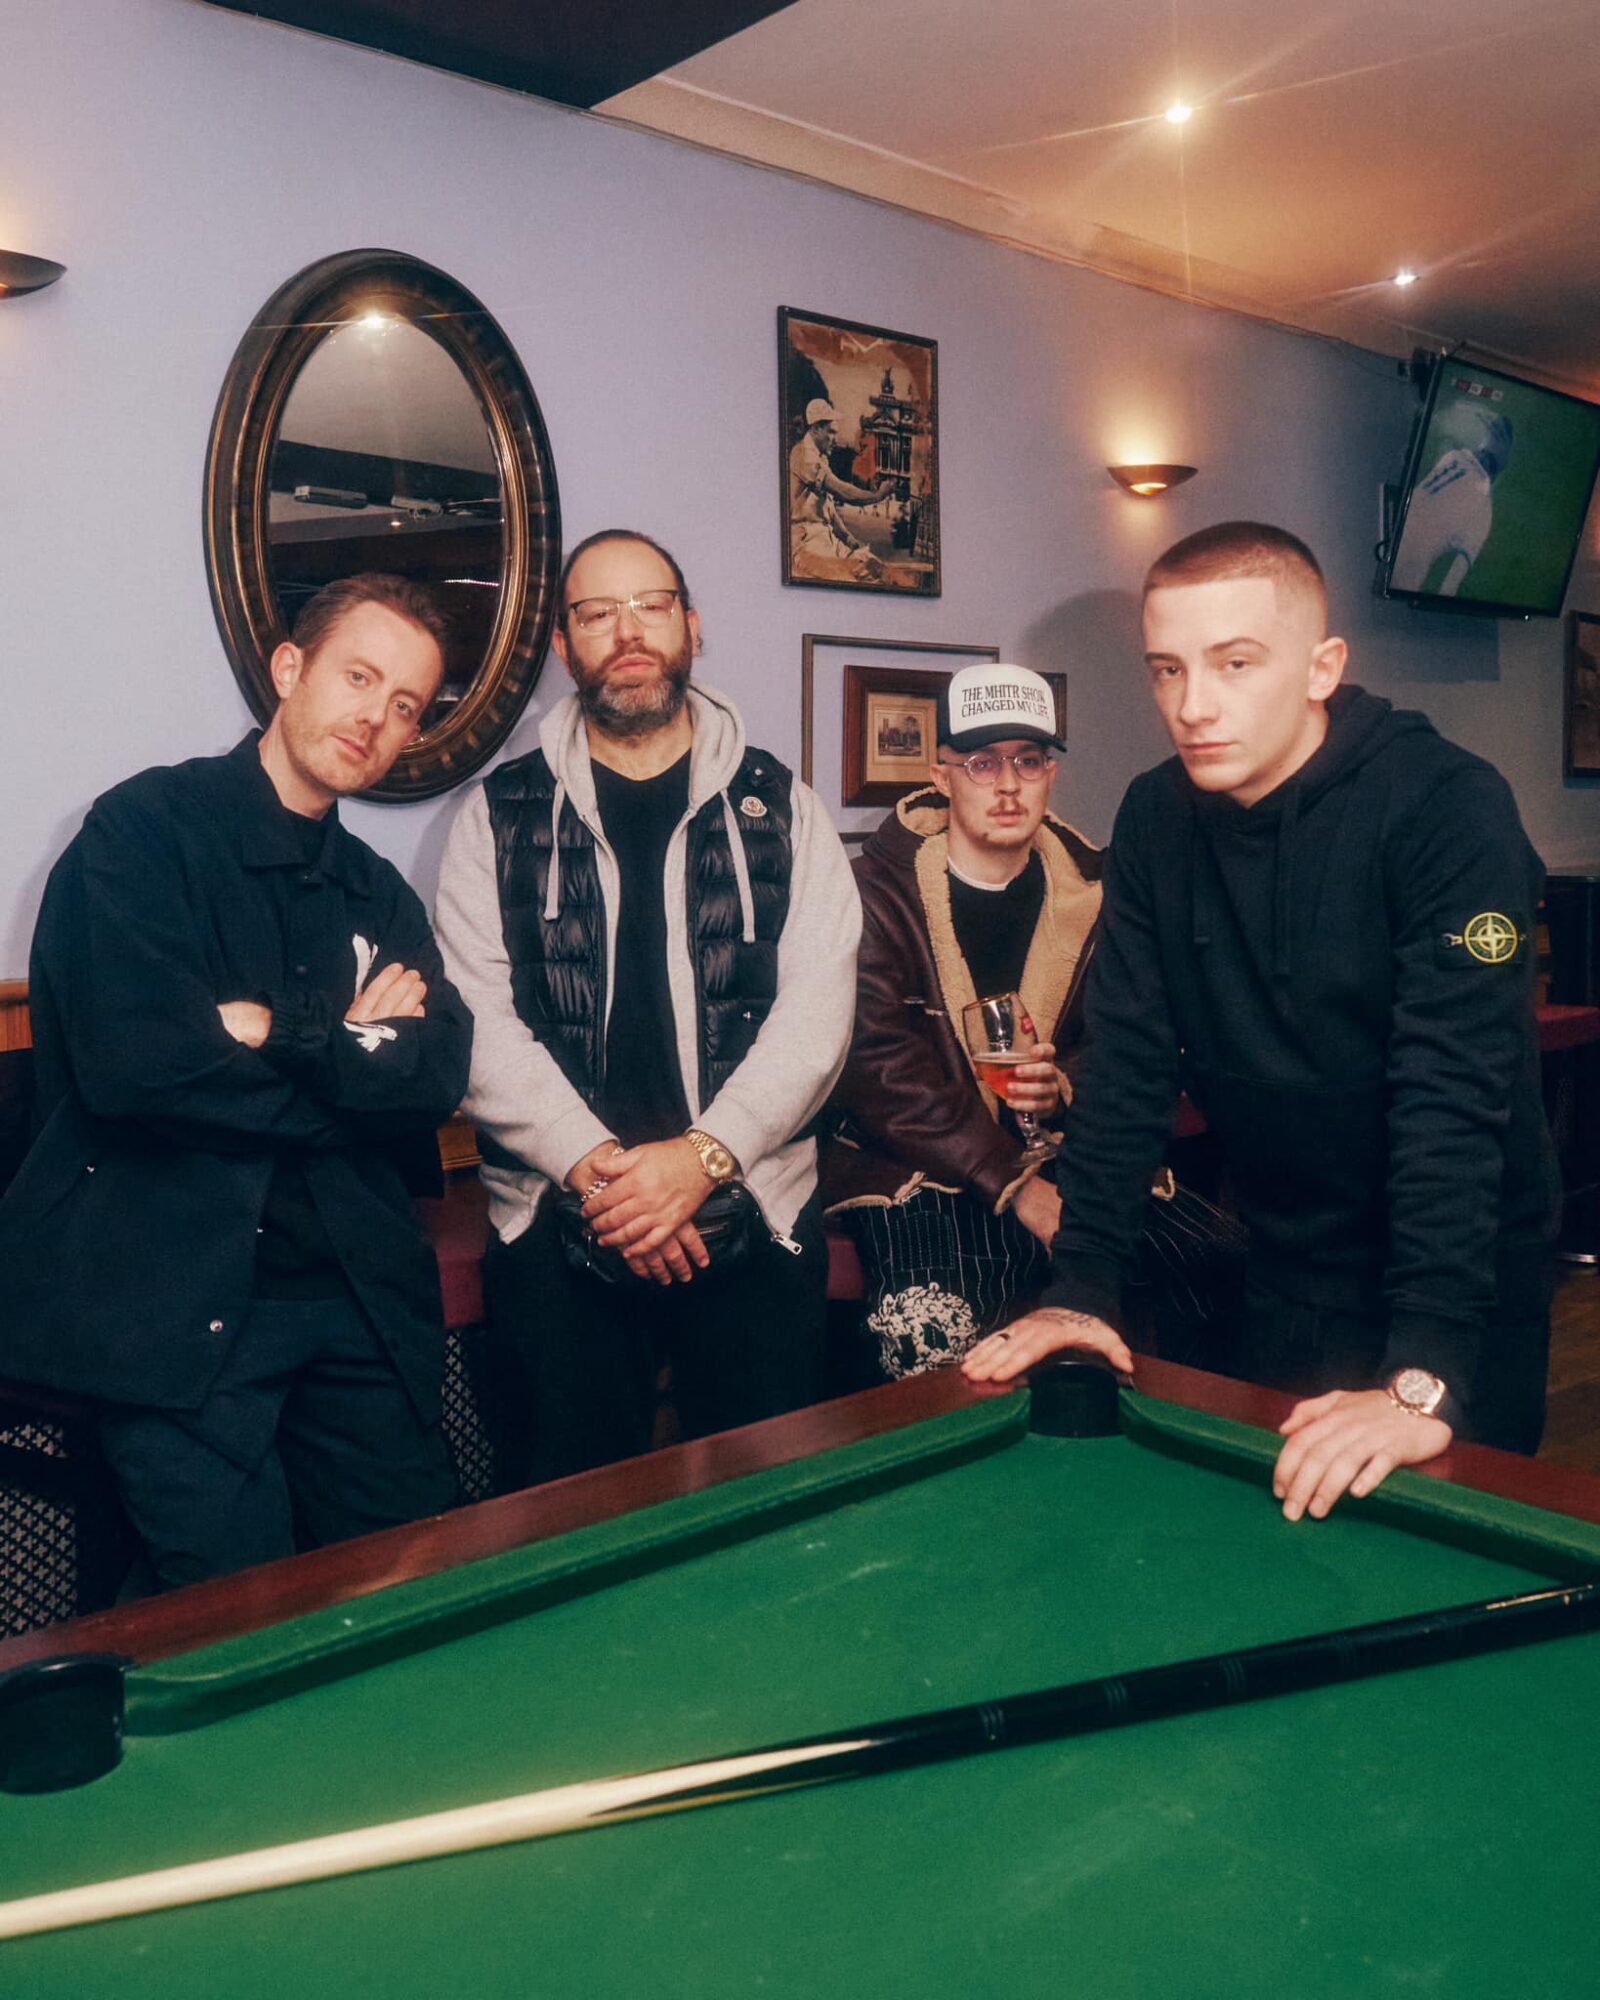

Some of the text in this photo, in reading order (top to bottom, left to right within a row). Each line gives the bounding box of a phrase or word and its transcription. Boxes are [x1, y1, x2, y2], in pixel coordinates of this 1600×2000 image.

[961, 686, 983, 703] THE
[961, 699, 1015, 718] CHANGED
[1017, 700, 1032, 714] MY
